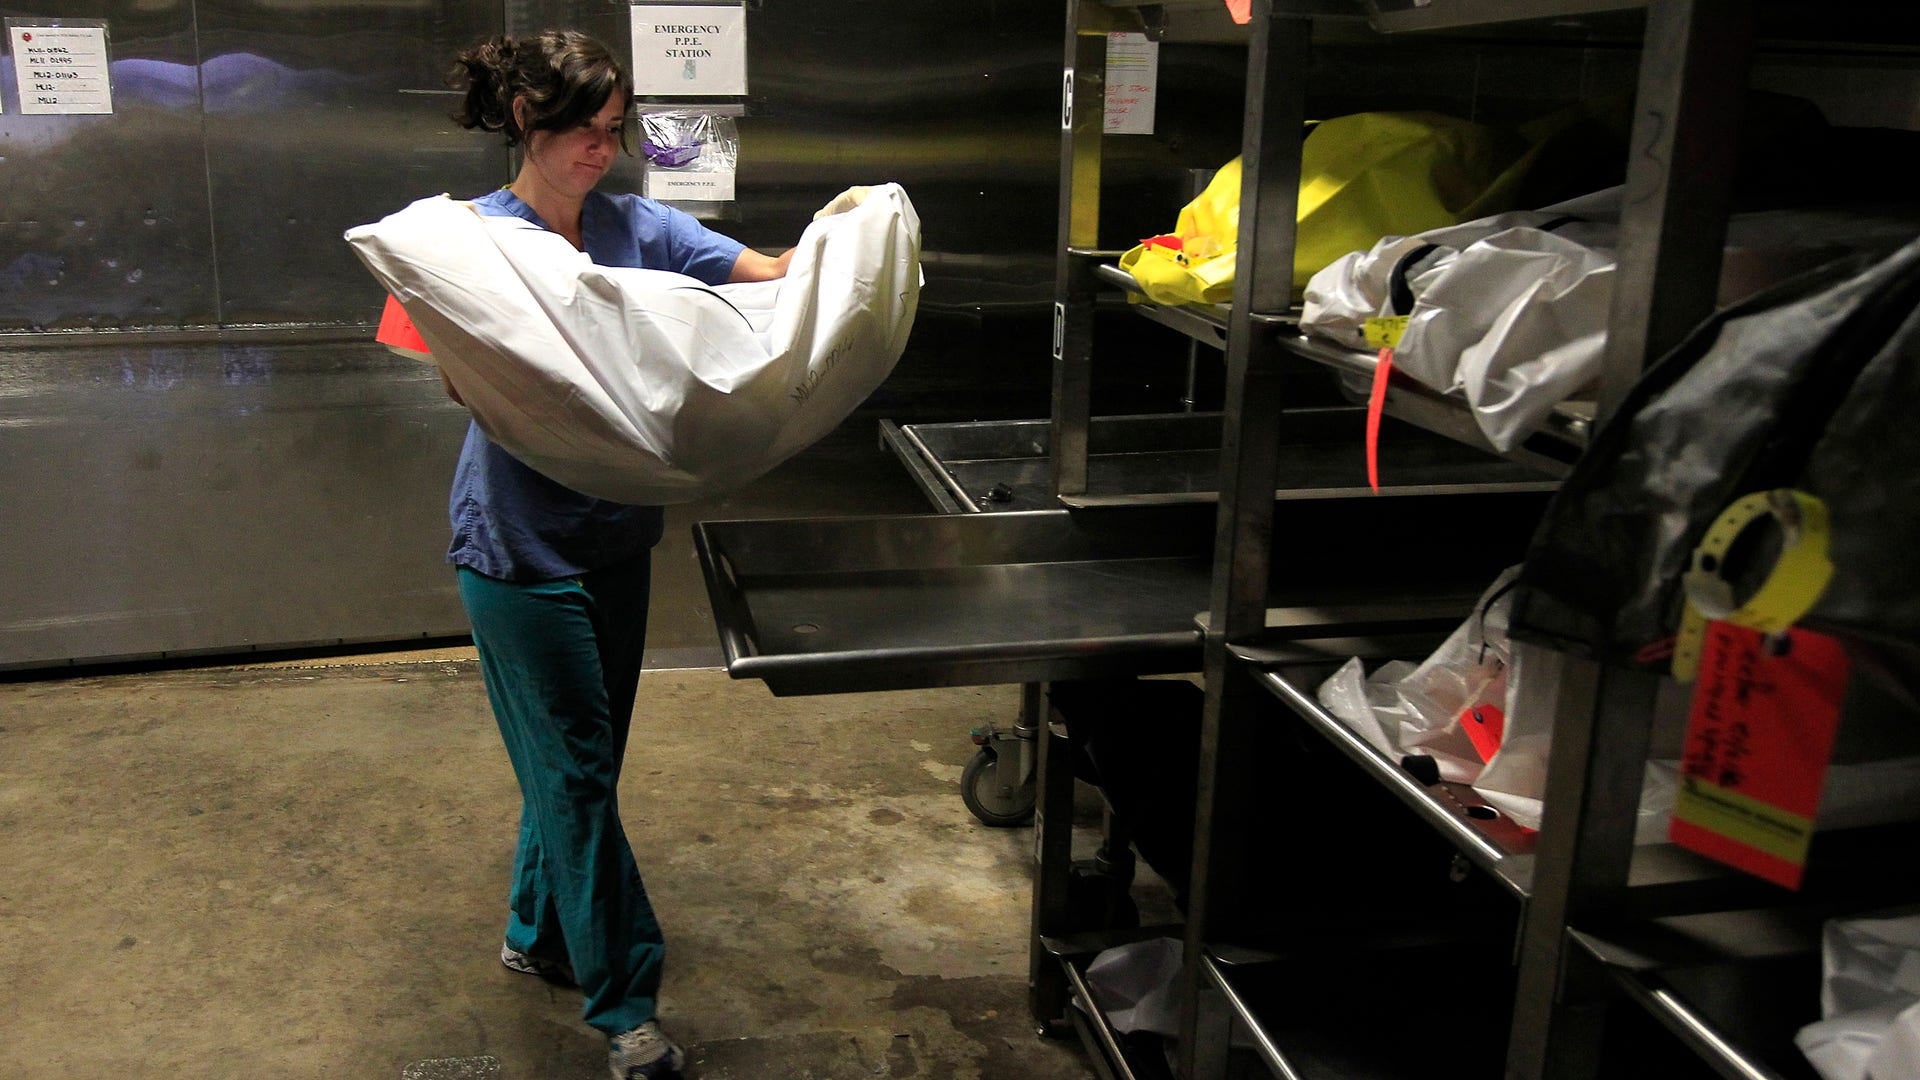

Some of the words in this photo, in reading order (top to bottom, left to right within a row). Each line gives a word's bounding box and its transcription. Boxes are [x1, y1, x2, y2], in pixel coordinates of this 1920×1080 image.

[655, 25, 720, 33] EMERGENCY
[675, 37, 702, 46] P.P.E.
[665, 49, 711, 58] STATION
[1064, 74, 1072, 126] C
